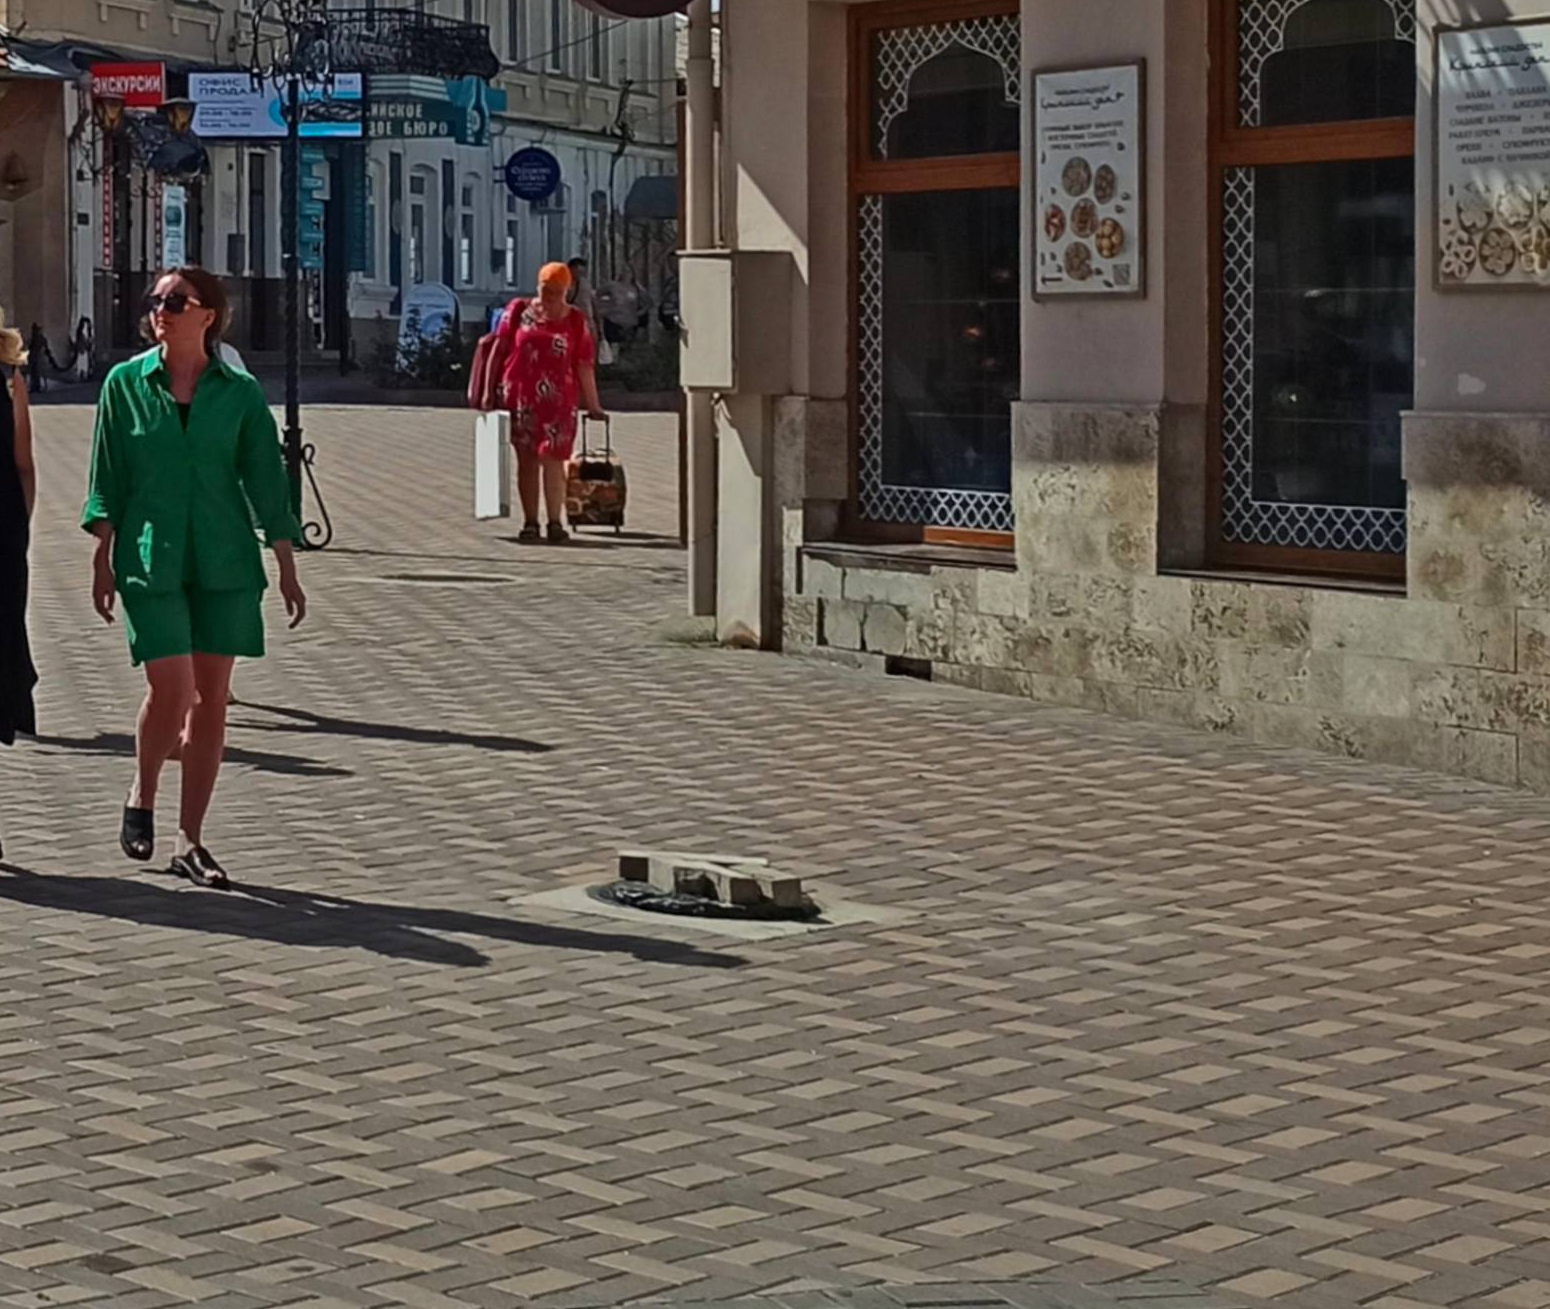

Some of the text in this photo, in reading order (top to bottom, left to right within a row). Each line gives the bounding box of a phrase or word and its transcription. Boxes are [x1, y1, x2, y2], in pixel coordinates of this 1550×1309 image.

[91, 74, 162, 93] ЭКСКУРСИИ
[198, 87, 251, 96] ПРОДА
[403, 120, 449, 137] БЮРО
